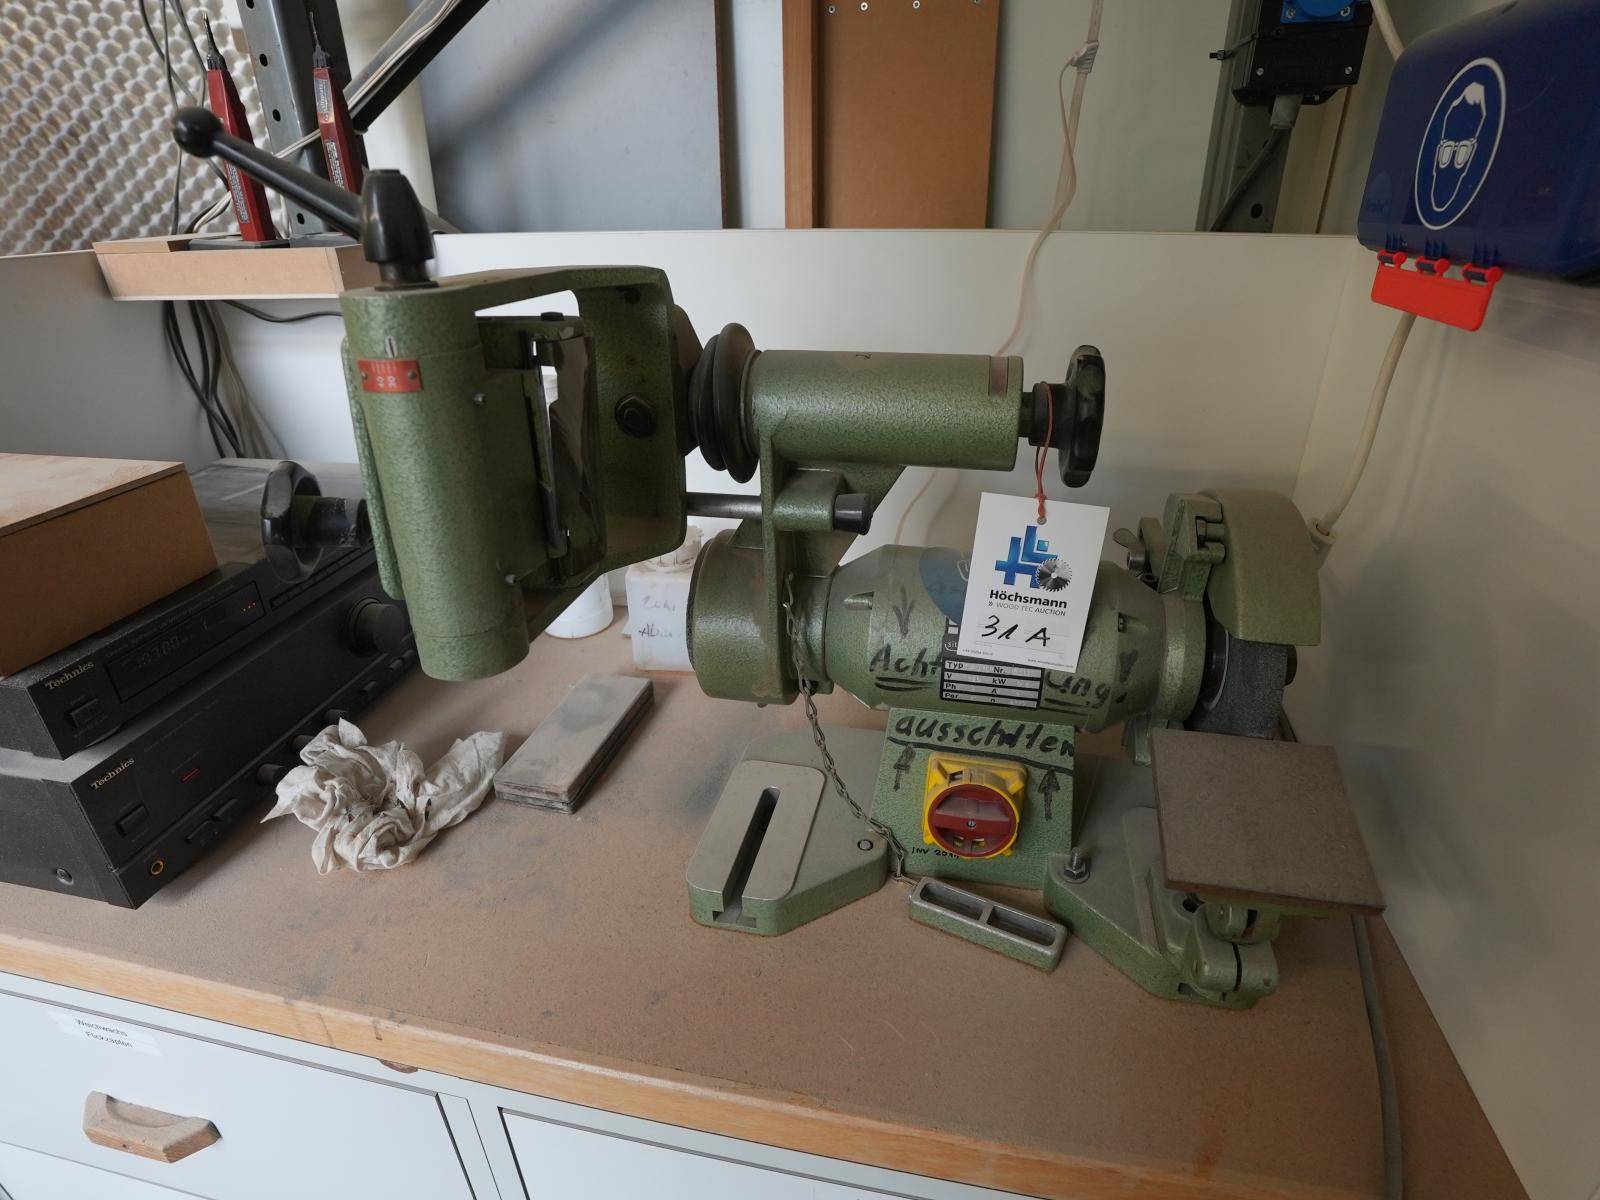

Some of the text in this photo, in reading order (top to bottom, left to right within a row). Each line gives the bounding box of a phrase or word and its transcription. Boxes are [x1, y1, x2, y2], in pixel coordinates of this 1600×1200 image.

[989, 589, 1068, 608] Höchsmann
[996, 602, 1066, 616] WOOD TEC AUCTION
[1025, 627, 1050, 646] A
[45, 661, 95, 690] Technics
[947, 661, 1006, 674] Typ Nr.
[90, 758, 135, 791] Technics
